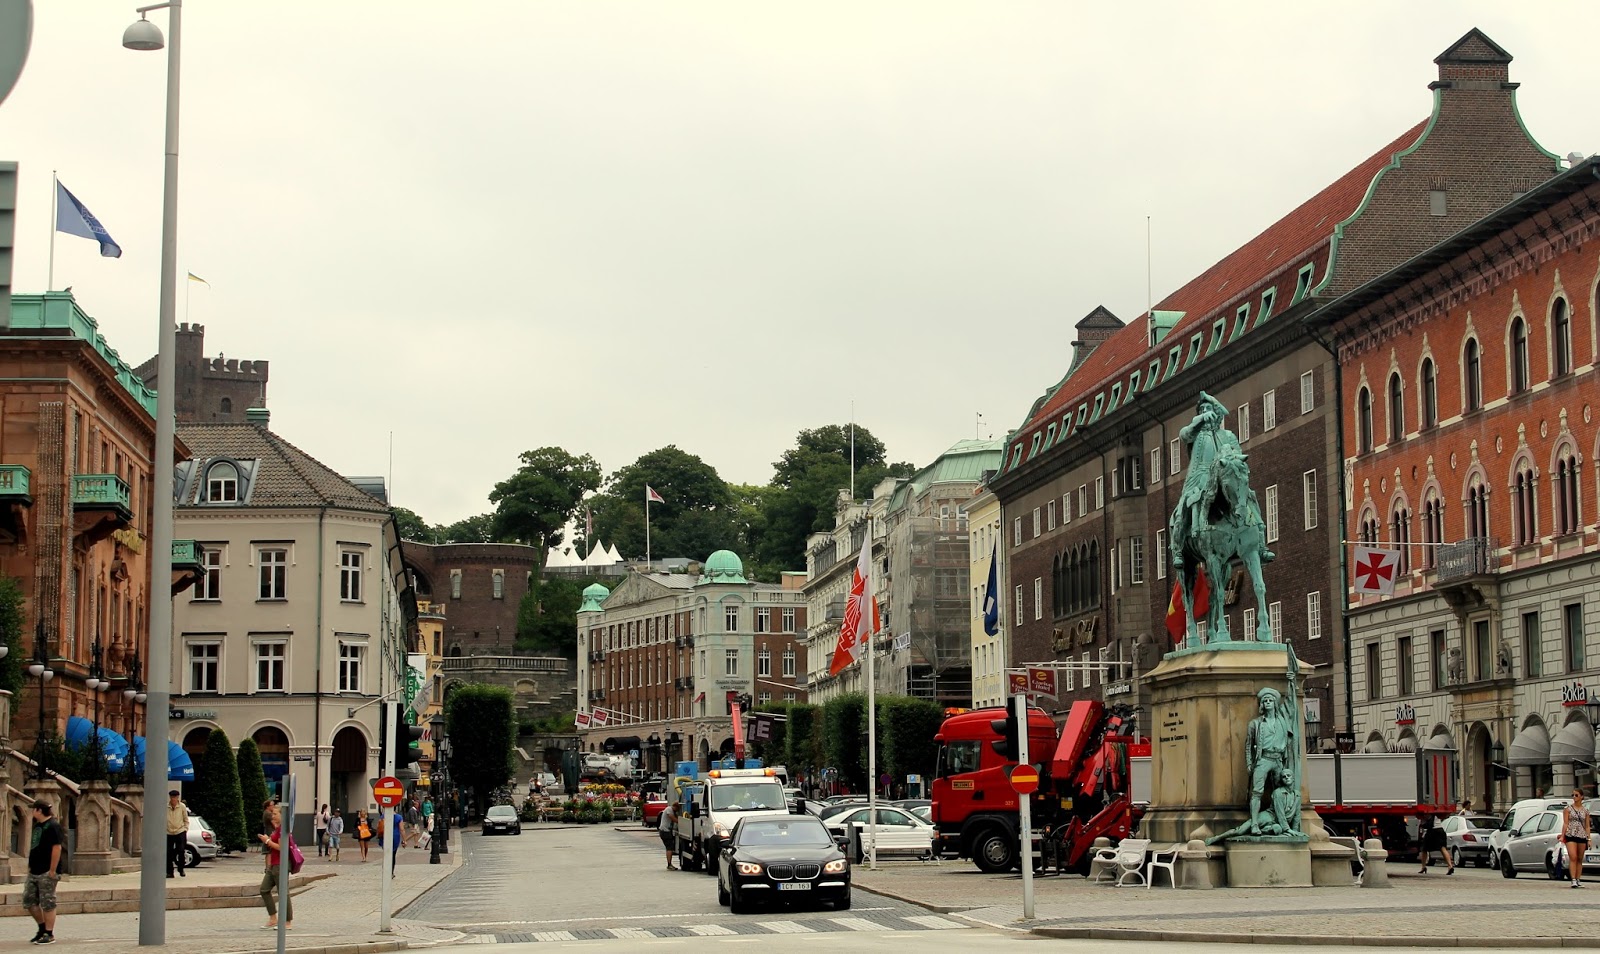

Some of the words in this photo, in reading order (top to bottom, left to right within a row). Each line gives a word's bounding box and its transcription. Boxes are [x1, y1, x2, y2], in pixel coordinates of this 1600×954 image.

[1076, 615, 1099, 647] Hotel
[1562, 682, 1587, 702] Bokia
[1395, 703, 1415, 721] Bokia
[798, 882, 811, 890] 163
